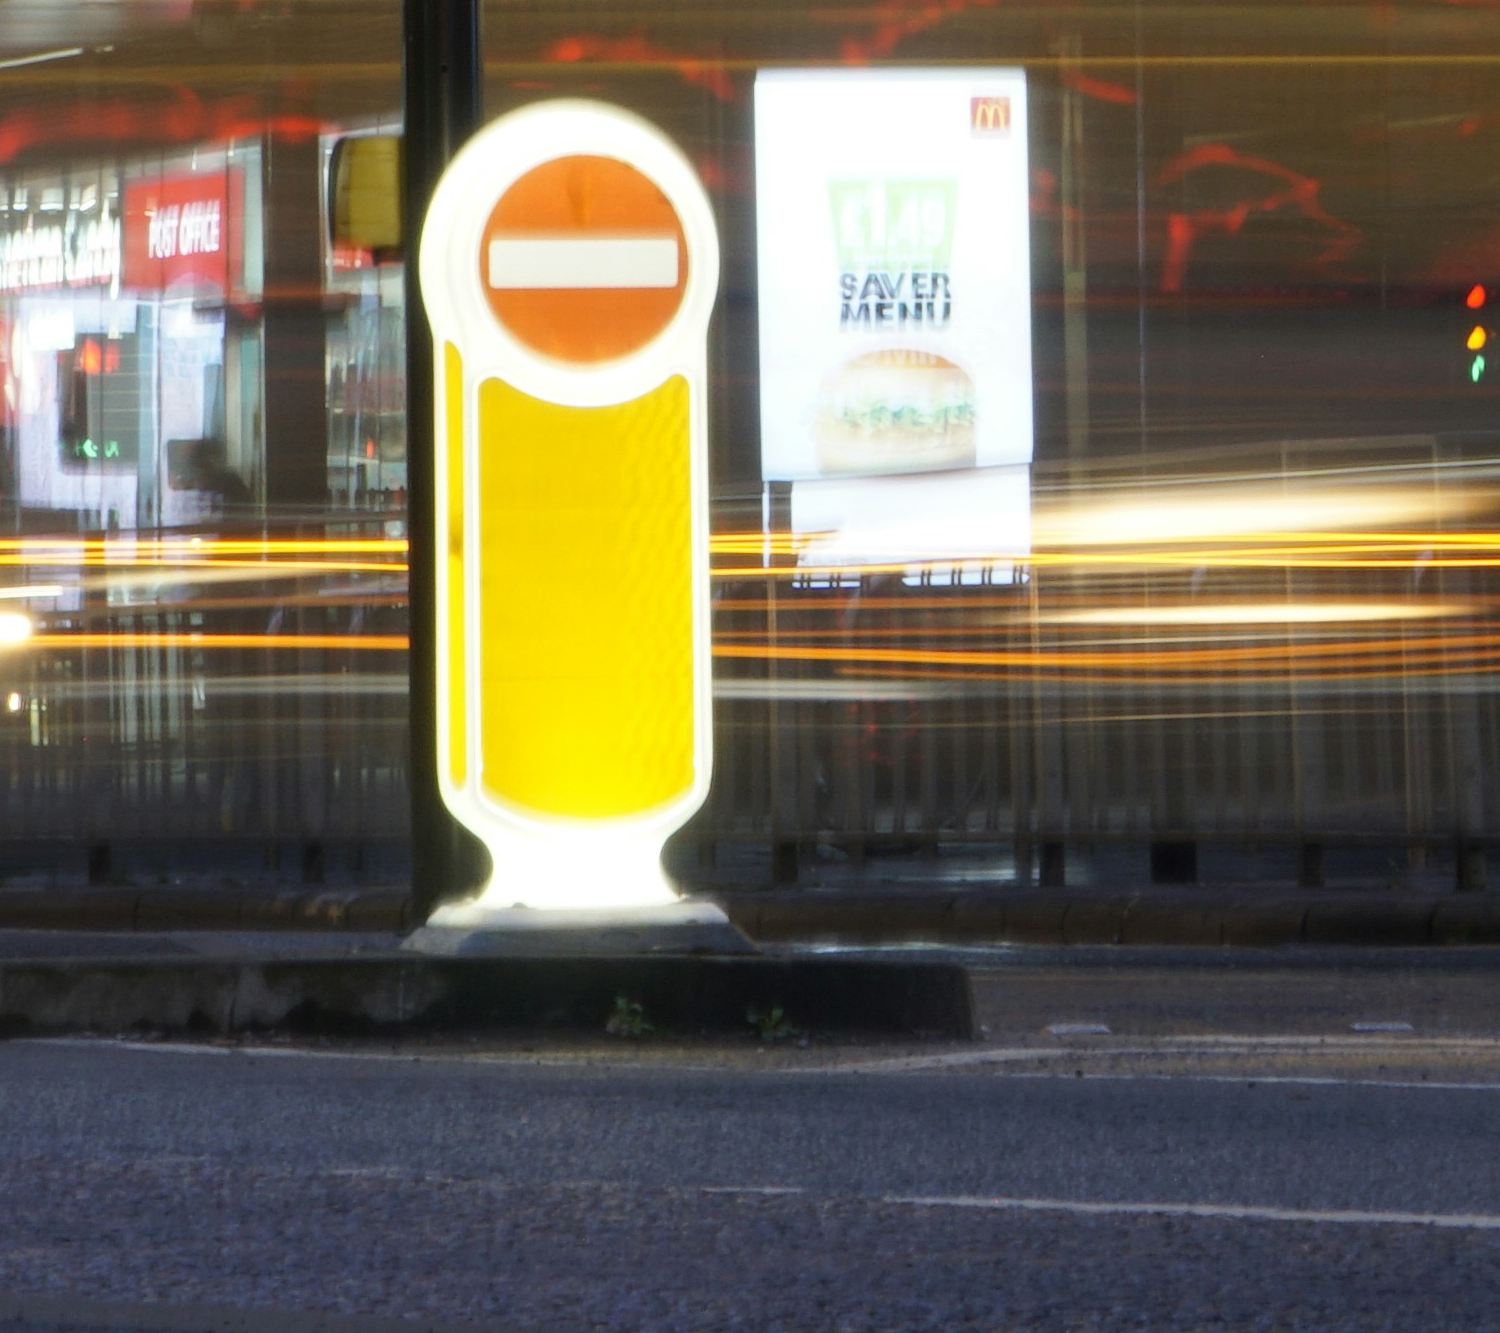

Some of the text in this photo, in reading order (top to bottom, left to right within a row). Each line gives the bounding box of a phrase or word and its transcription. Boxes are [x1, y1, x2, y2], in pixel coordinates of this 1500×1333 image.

[148, 201, 220, 259] POST OFFICE
[839, 273, 951, 299] SAVER
[839, 302, 951, 330] MENU
